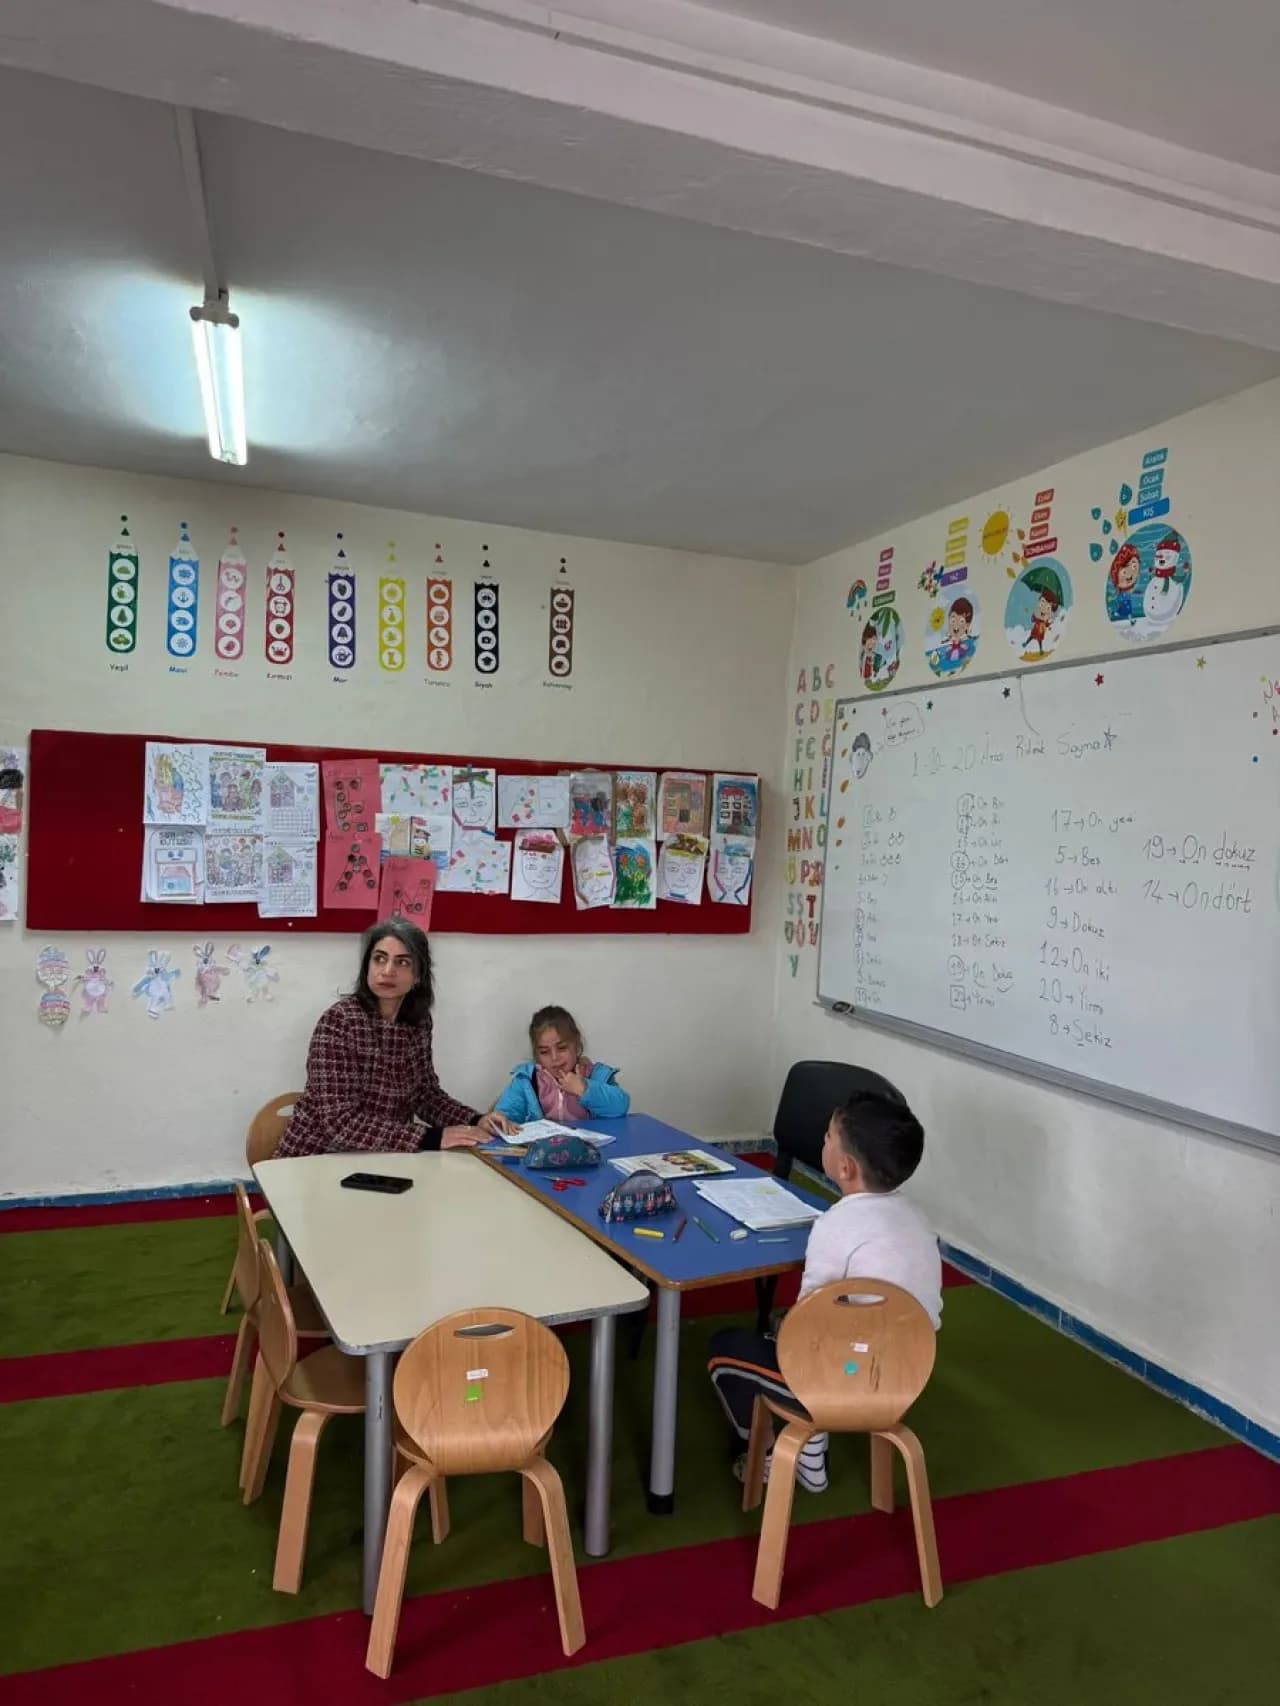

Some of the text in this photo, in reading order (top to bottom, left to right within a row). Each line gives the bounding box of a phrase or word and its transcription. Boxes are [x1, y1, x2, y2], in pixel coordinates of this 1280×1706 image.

[797, 664, 835, 694] A B C
[794, 768, 804, 791] H
[805, 796, 815, 820] K
[819, 793, 827, 817] L
[1050, 808, 1073, 833] 17
[1088, 811, 1103, 829] On
[802, 826, 813, 850] N
[1142, 829, 1257, 862] 19 On dokuz
[1055, 845, 1068, 864] 5
[800, 860, 810, 884] P
[1142, 878, 1164, 904] 14
[806, 894, 816, 918] T
[1046, 905, 1058, 929] 9
[789, 954, 799, 977] Y
[1039, 940, 1060, 967] 12
[1072, 947, 1089, 977] On
[1039, 977, 1062, 1004] 20
[1048, 1013, 1060, 1036] 8
